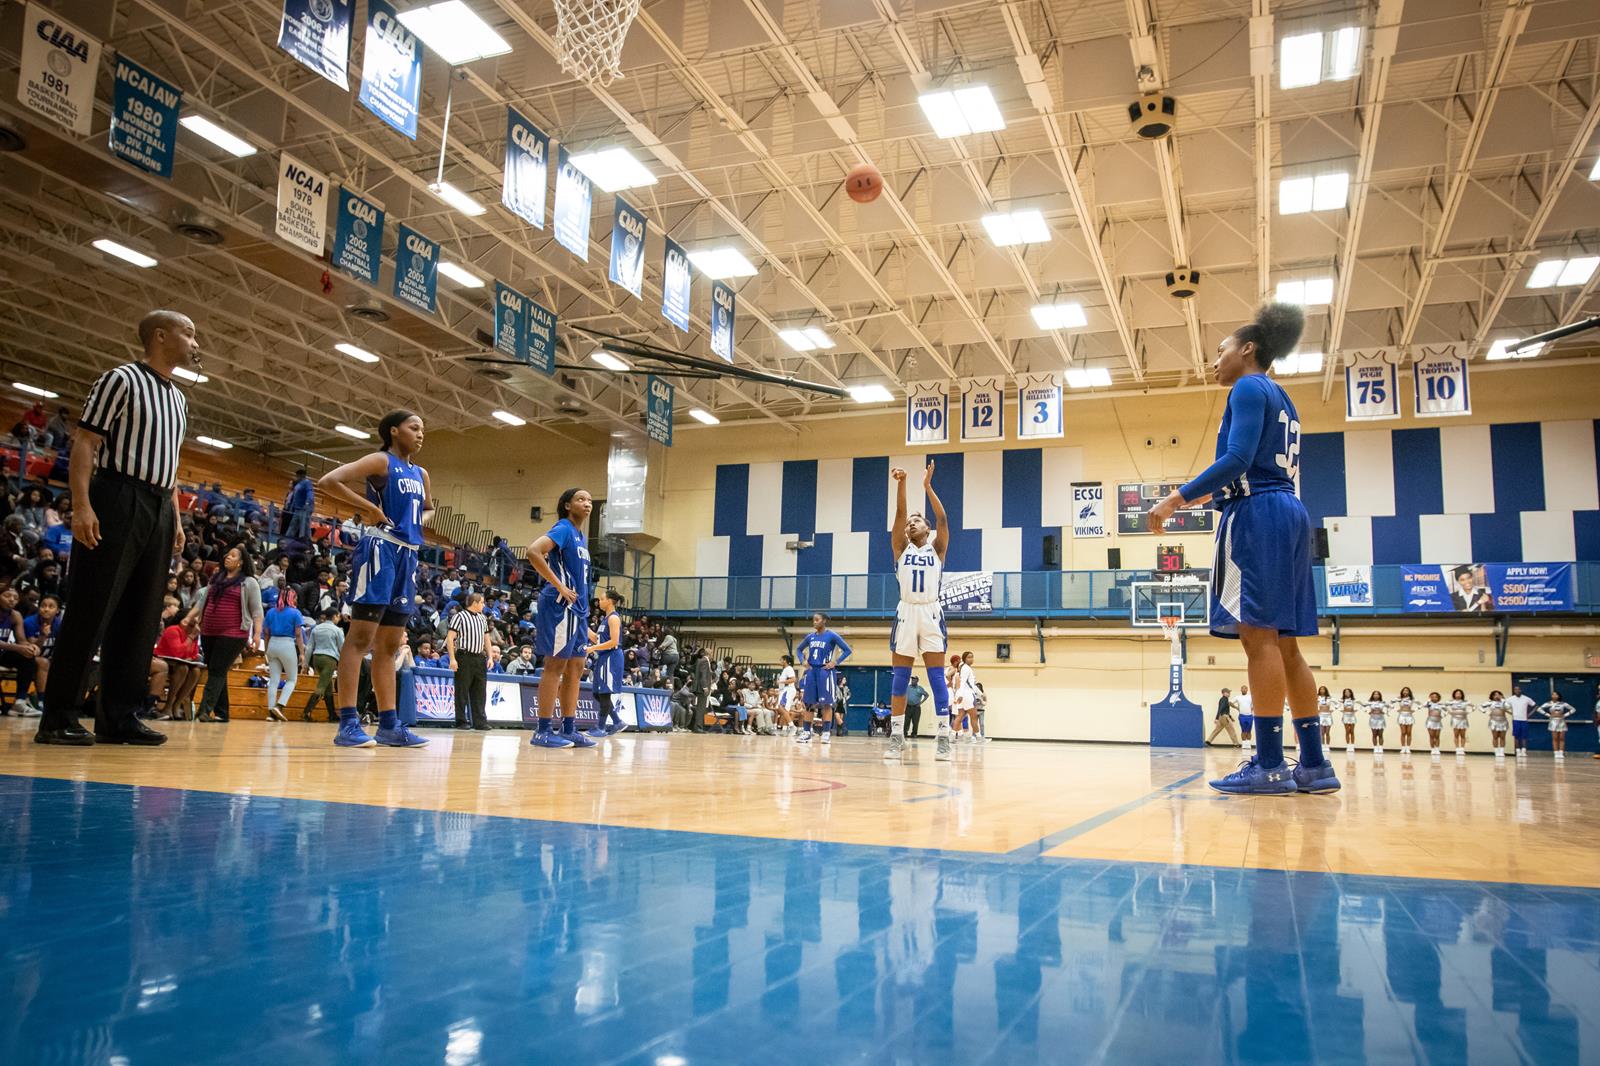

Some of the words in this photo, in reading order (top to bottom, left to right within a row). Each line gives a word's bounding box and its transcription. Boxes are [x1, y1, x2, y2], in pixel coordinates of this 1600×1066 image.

[36, 19, 89, 64] CIAA
[373, 11, 416, 62] CIAA
[28, 80, 78, 111] BASKETBALL
[41, 72, 69, 97] 1981
[117, 62, 178, 109] NCAIAW
[27, 88, 78, 120] TOURNAMENT
[28, 99, 74, 127] CHAMPIONS
[127, 97, 163, 126] 1980
[114, 118, 166, 152] BASKETBALL
[122, 111, 161, 137] WOMEN'S
[512, 123, 544, 163] CIAA
[113, 140, 162, 172] CHAMPIONS
[285, 164, 324, 197] NCAA
[293, 188, 313, 205] 1978
[285, 207, 316, 228] ATLANTIC
[290, 200, 313, 217] SOUTH
[347, 198, 377, 227] CIAA
[278, 212, 321, 239] BASKETBALL
[279, 223, 319, 248] CHAMPIONS
[619, 210, 644, 241] CIAA
[344, 243, 370, 262] WOMEN'S
[349, 235, 368, 252] 2002
[406, 234, 433, 261] CIAA
[339, 258, 371, 279] CHAMPIONS
[342, 251, 370, 270] SOFTBALL
[408, 268, 424, 284] 2003
[500, 289, 522, 313] CIAA
[714, 287, 733, 312] CIAA
[530, 305, 552, 328] NAIA
[1419, 366, 1460, 375] TROTMAN
[651, 380, 670, 403] CIAA
[1357, 379, 1386, 404] 75
[1426, 375, 1456, 400] 10
[913, 408, 942, 430] 00
[972, 405, 993, 427] 12
[1033, 402, 1049, 423] 3
[398, 477, 426, 500] CHOW
[1074, 488, 1102, 500] ECSU
[1074, 526, 1104, 535] VIKINGS
[1131, 519, 1137, 528] 2
[904, 554, 935, 567] ECSU
[1162, 556, 1179, 571] 30
[1506, 567, 1527, 575] APPLY
[1528, 567, 1548, 575] NOW!
[912, 569, 925, 592] 11
[940, 575, 993, 600] THLETICS
[813, 649, 819, 660] 4
[555, 707, 599, 720] UERSITY
[578, 699, 593, 710] CITY
